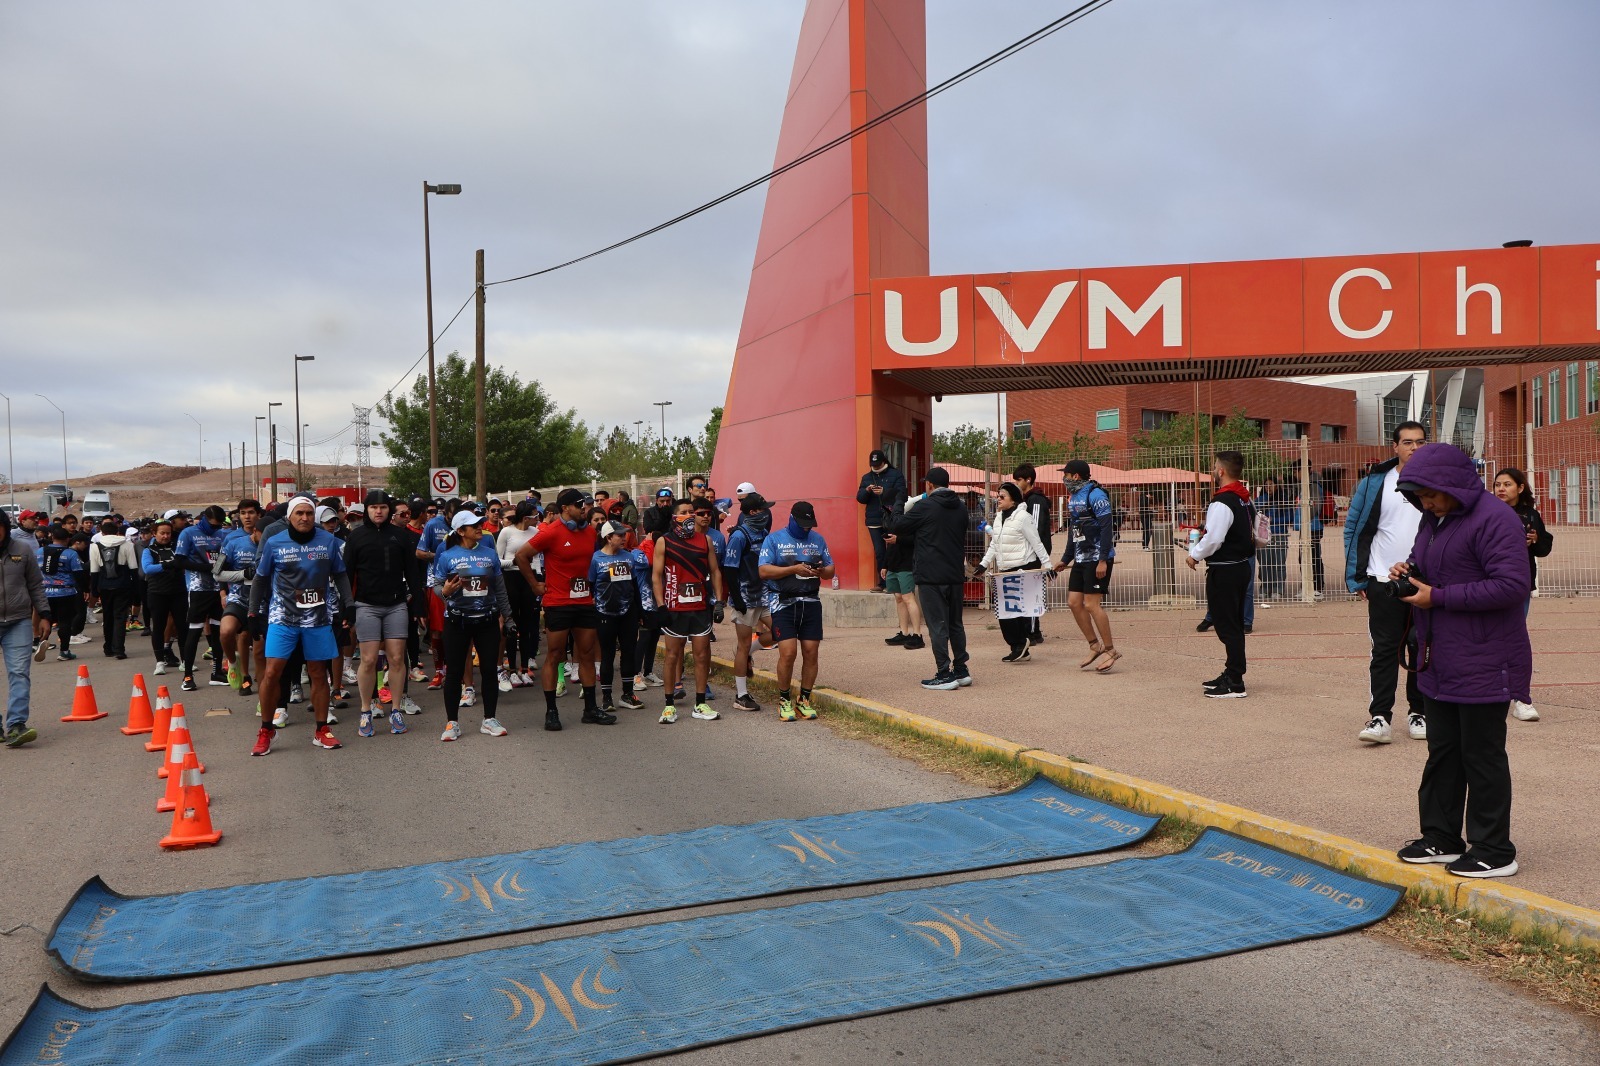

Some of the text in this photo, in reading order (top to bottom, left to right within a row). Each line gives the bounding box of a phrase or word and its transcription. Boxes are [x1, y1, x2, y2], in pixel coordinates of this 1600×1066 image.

[885, 277, 1182, 356] UVM
[278, 546, 299, 556] Medio
[614, 566, 627, 575] 423
[470, 580, 481, 590] 92
[574, 581, 586, 592] 451
[685, 586, 695, 597] 41
[302, 592, 318, 603] 150
[1205, 851, 1282, 878] ACTIVE
